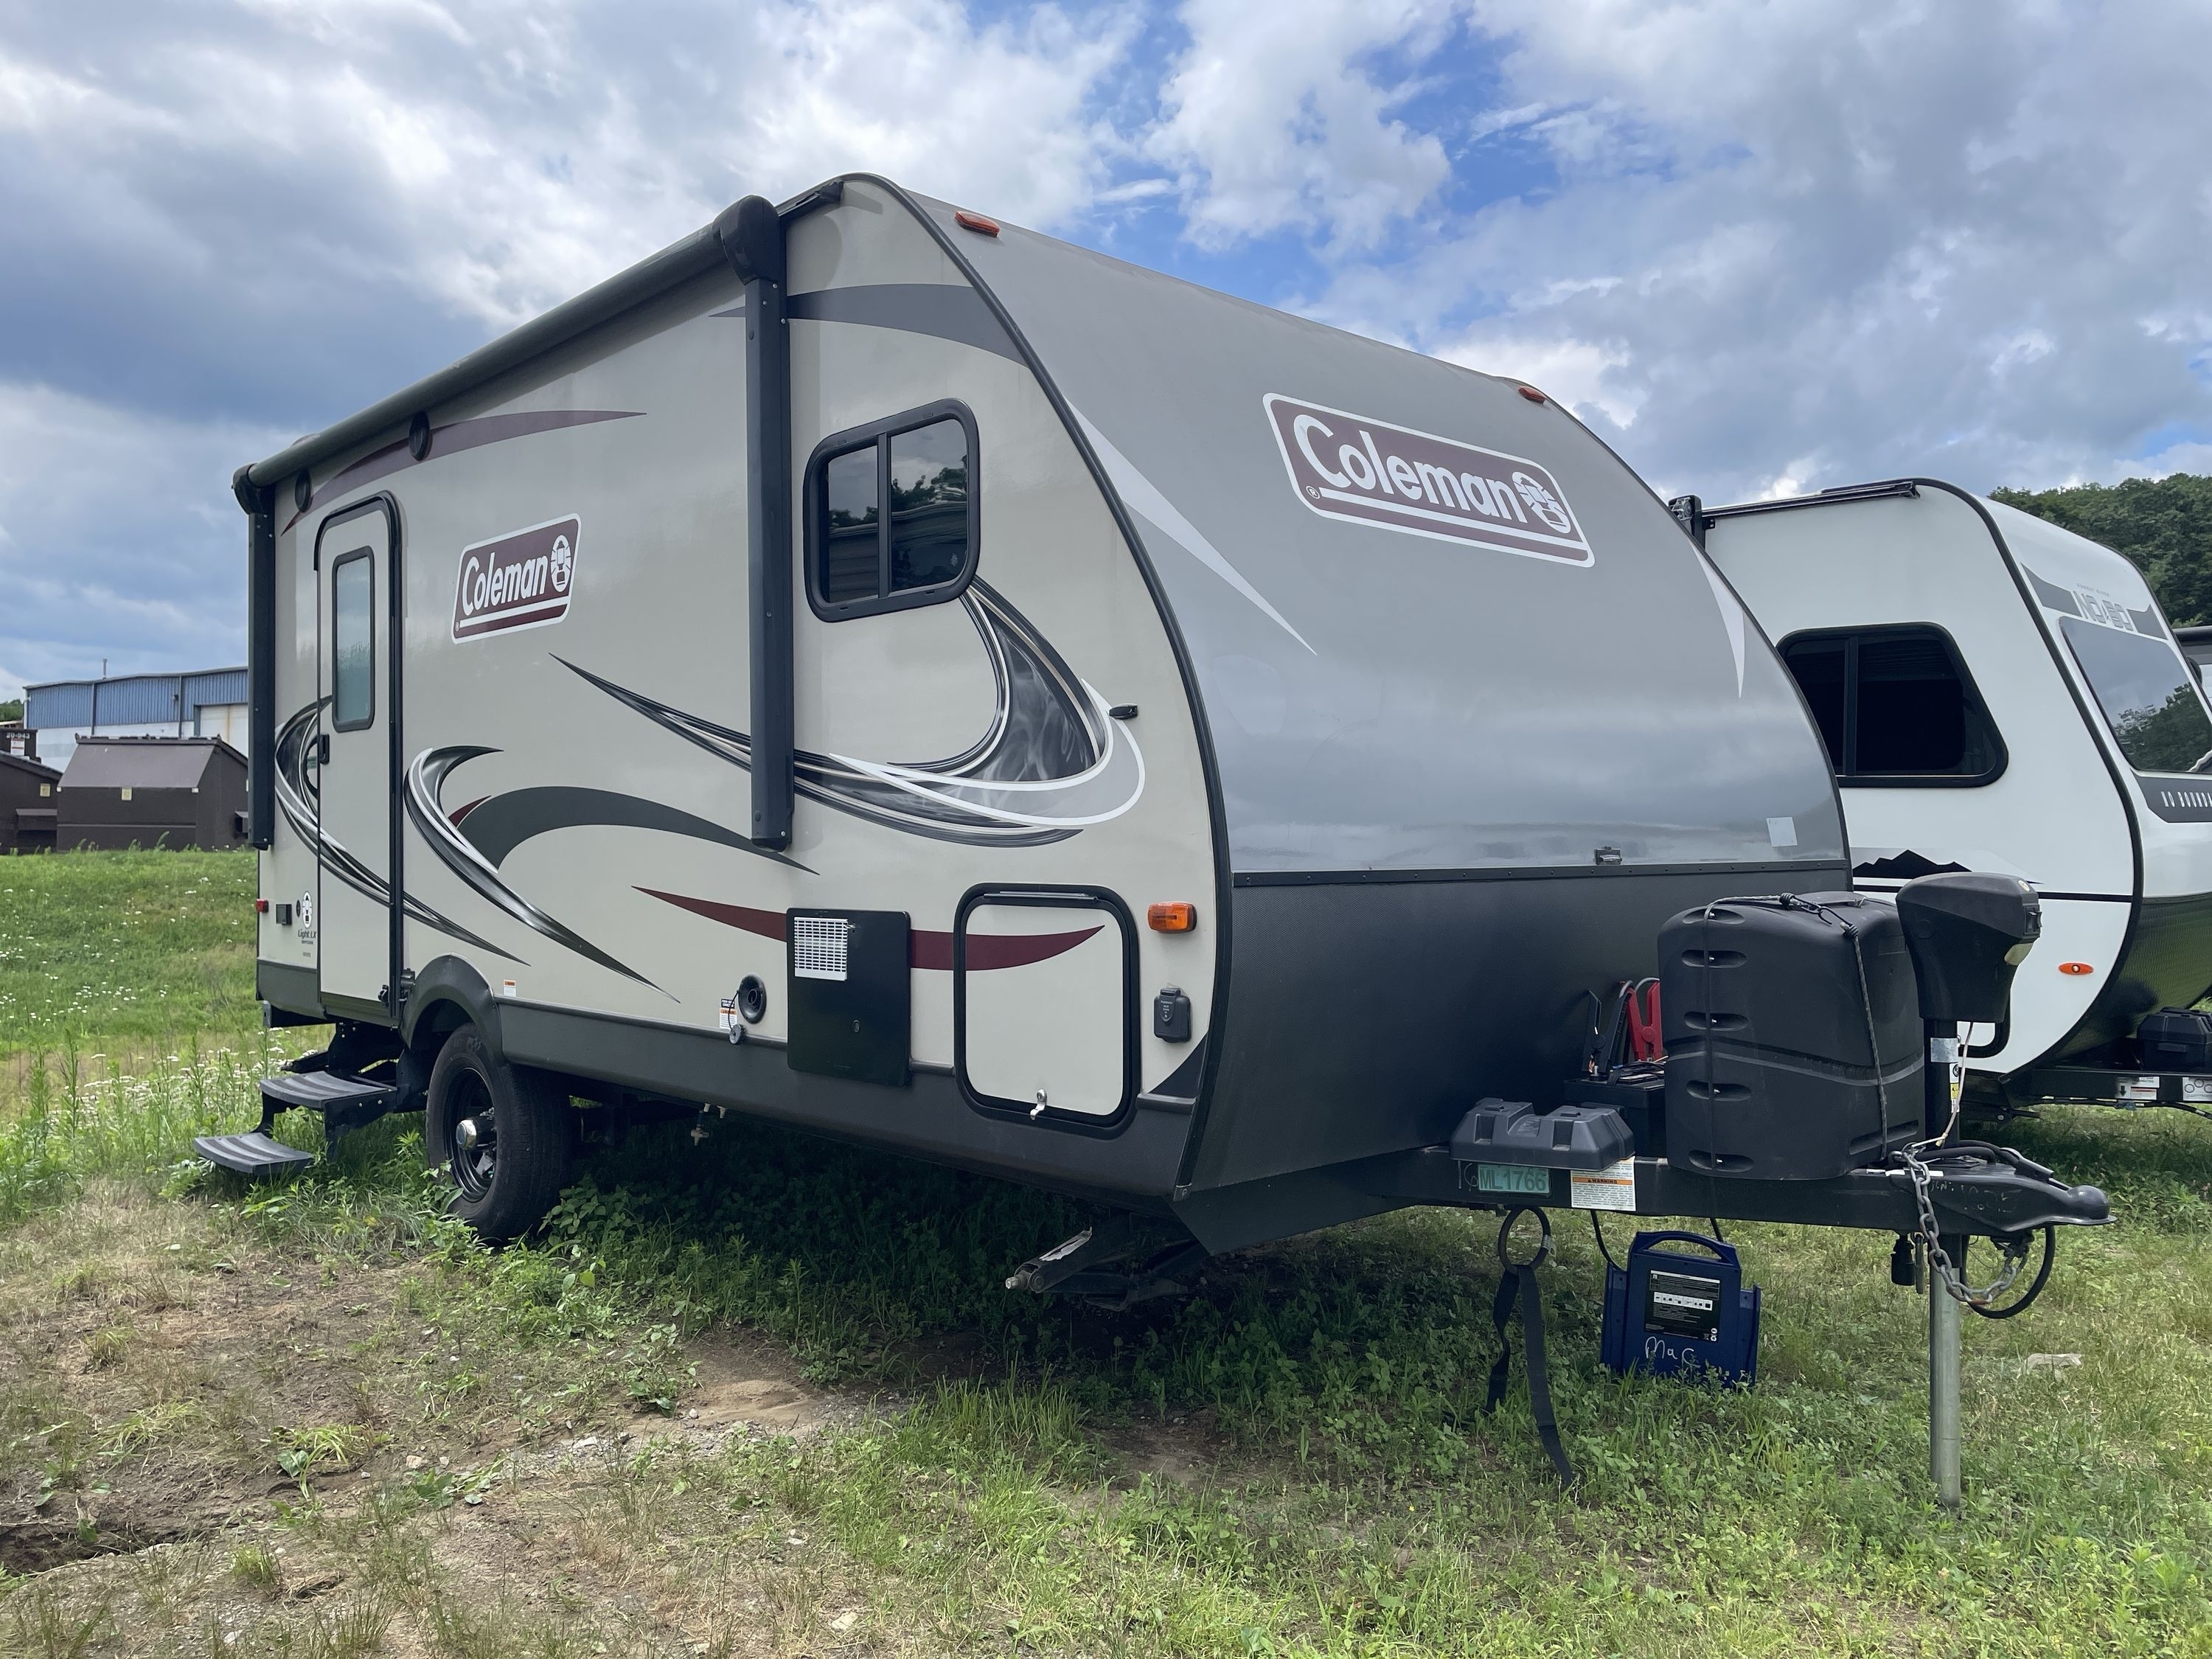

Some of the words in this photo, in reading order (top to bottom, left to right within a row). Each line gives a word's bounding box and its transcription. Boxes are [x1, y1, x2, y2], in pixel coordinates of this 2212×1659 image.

[1293, 414, 1528, 524] Coleman
[462, 552, 548, 616] Coleman
[298, 928, 310, 939] Light
[310, 931, 317, 939] LX
